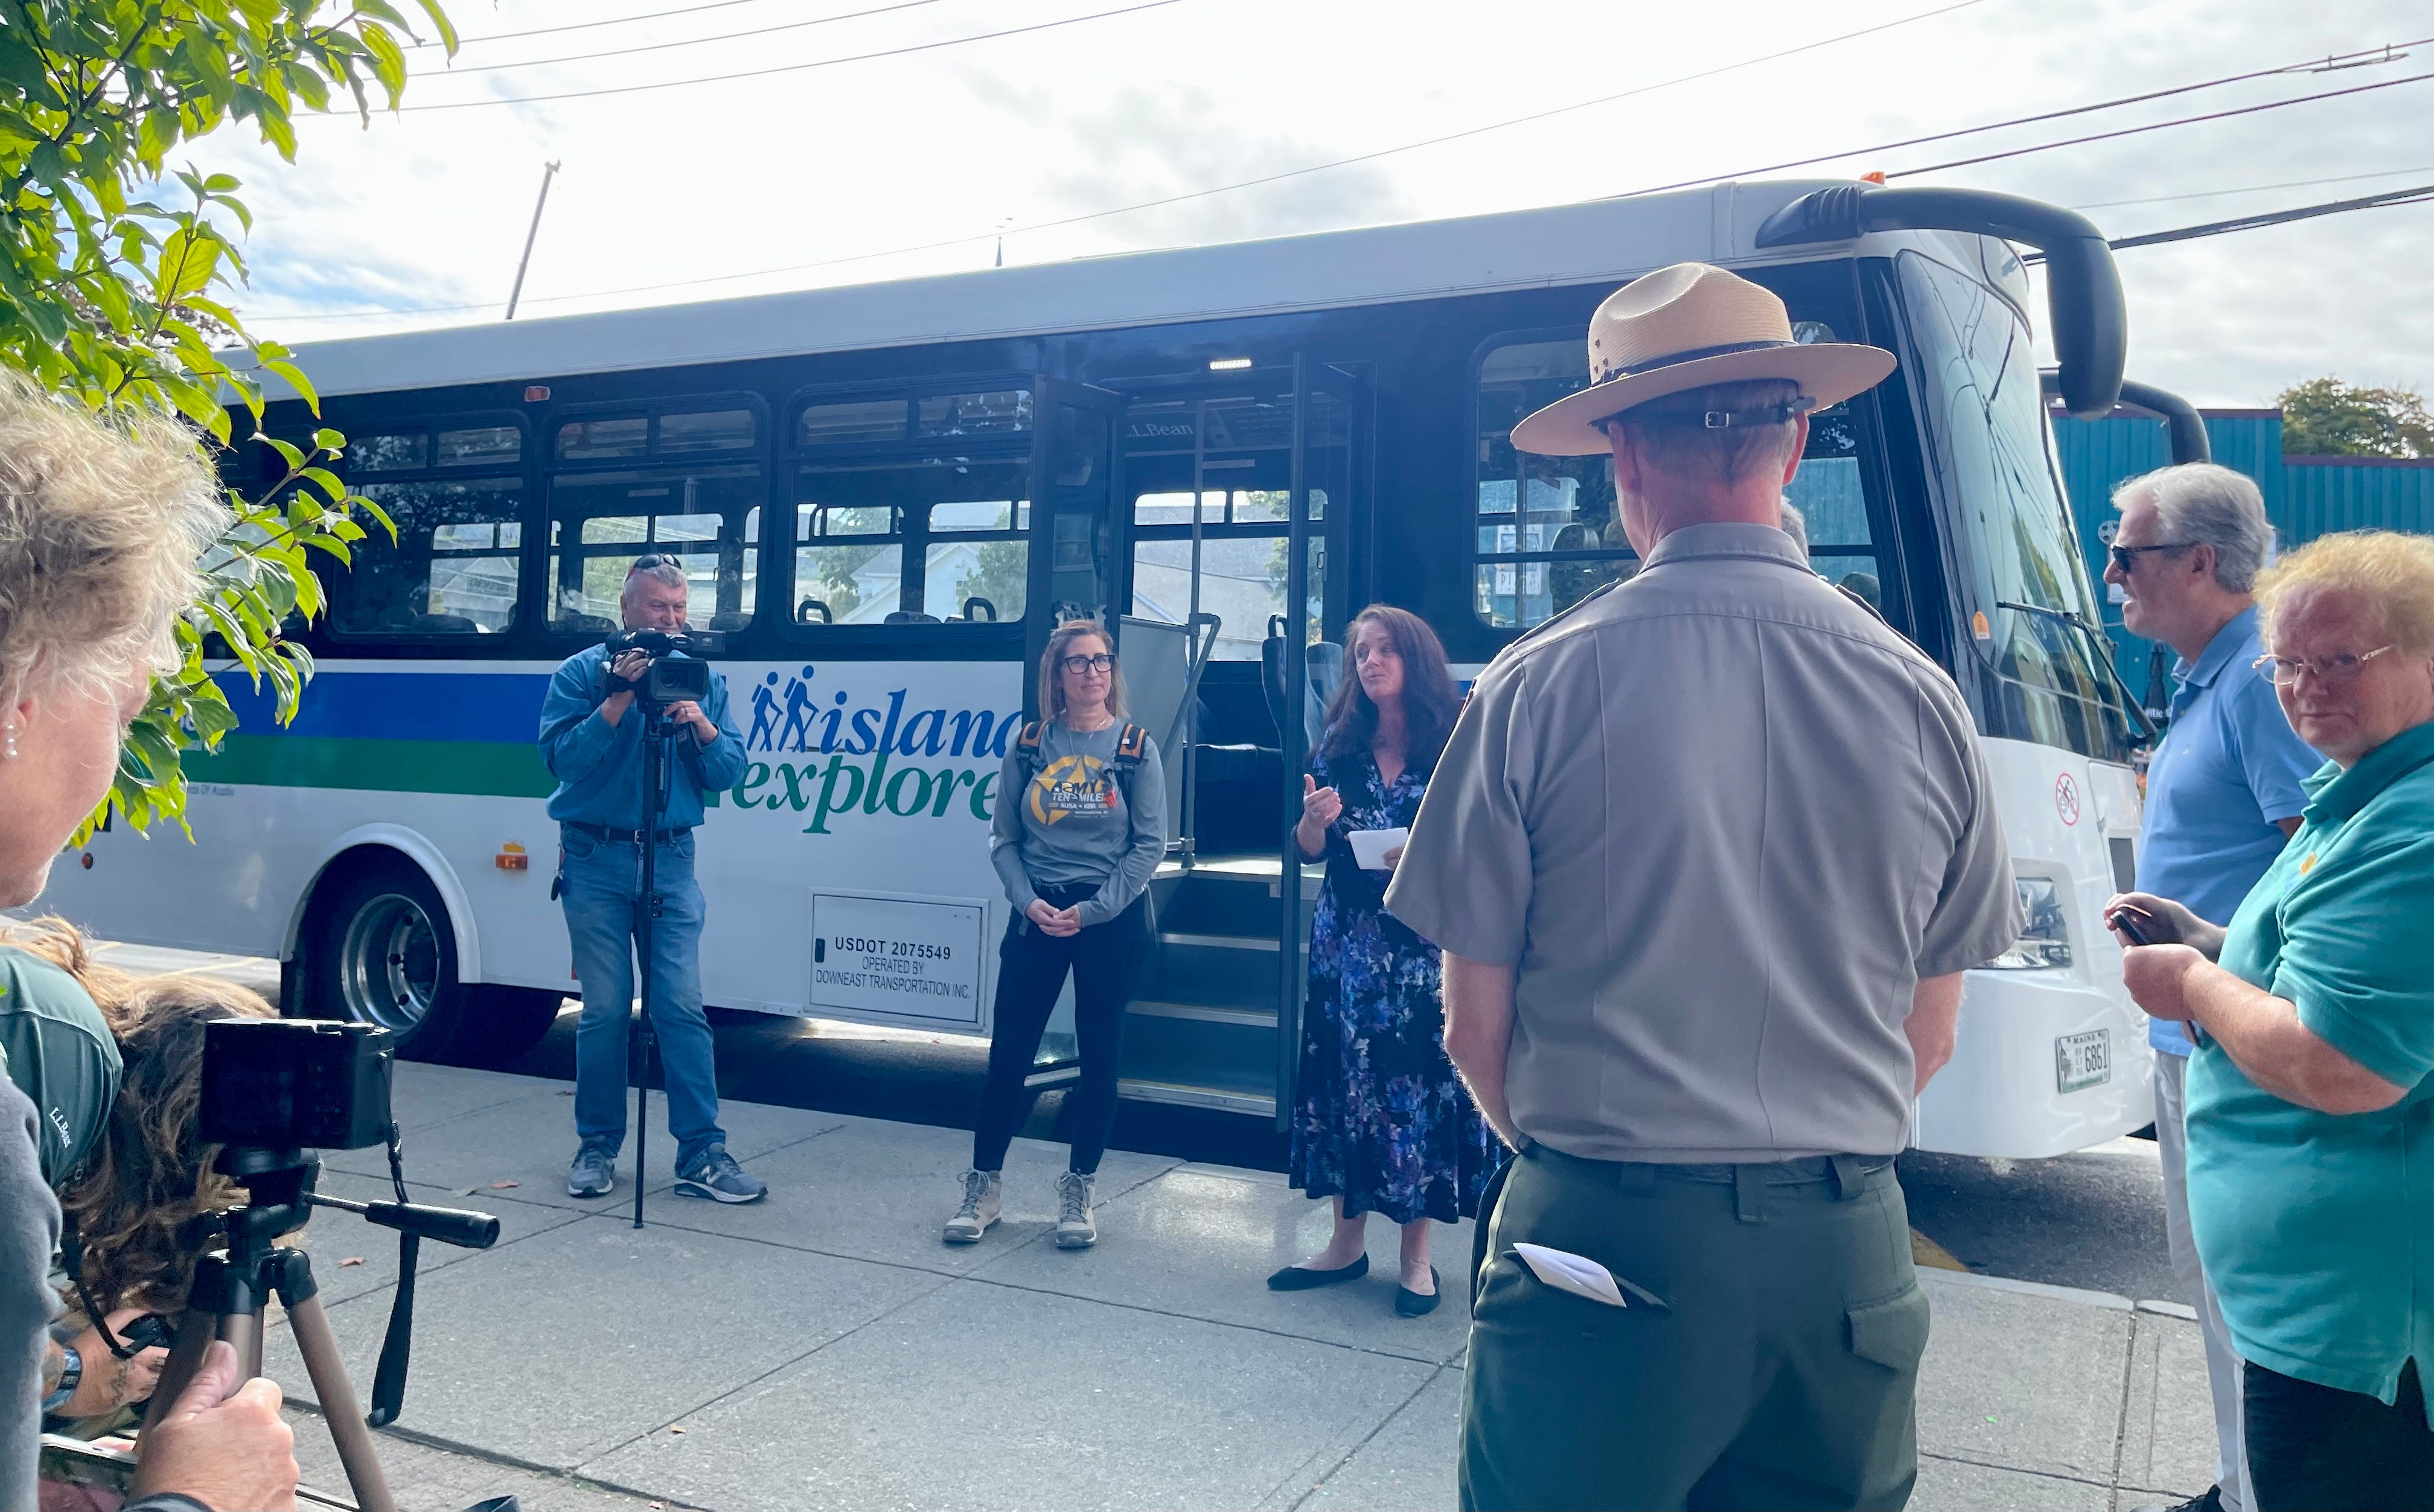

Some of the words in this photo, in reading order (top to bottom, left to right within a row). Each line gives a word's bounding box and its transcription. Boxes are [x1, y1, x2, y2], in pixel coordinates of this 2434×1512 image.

[1051, 779, 1099, 794] ARMY
[835, 936, 886, 954] USDOT
[892, 942, 951, 960] 2075549
[862, 955, 910, 974] OPERATED
[912, 961, 925, 975] BY
[816, 969, 867, 987] DOWNEAST
[869, 974, 950, 997] TRANSPORTATION
[2074, 1034, 2096, 1044] MAINE
[2085, 1042, 2107, 1072] 6861
